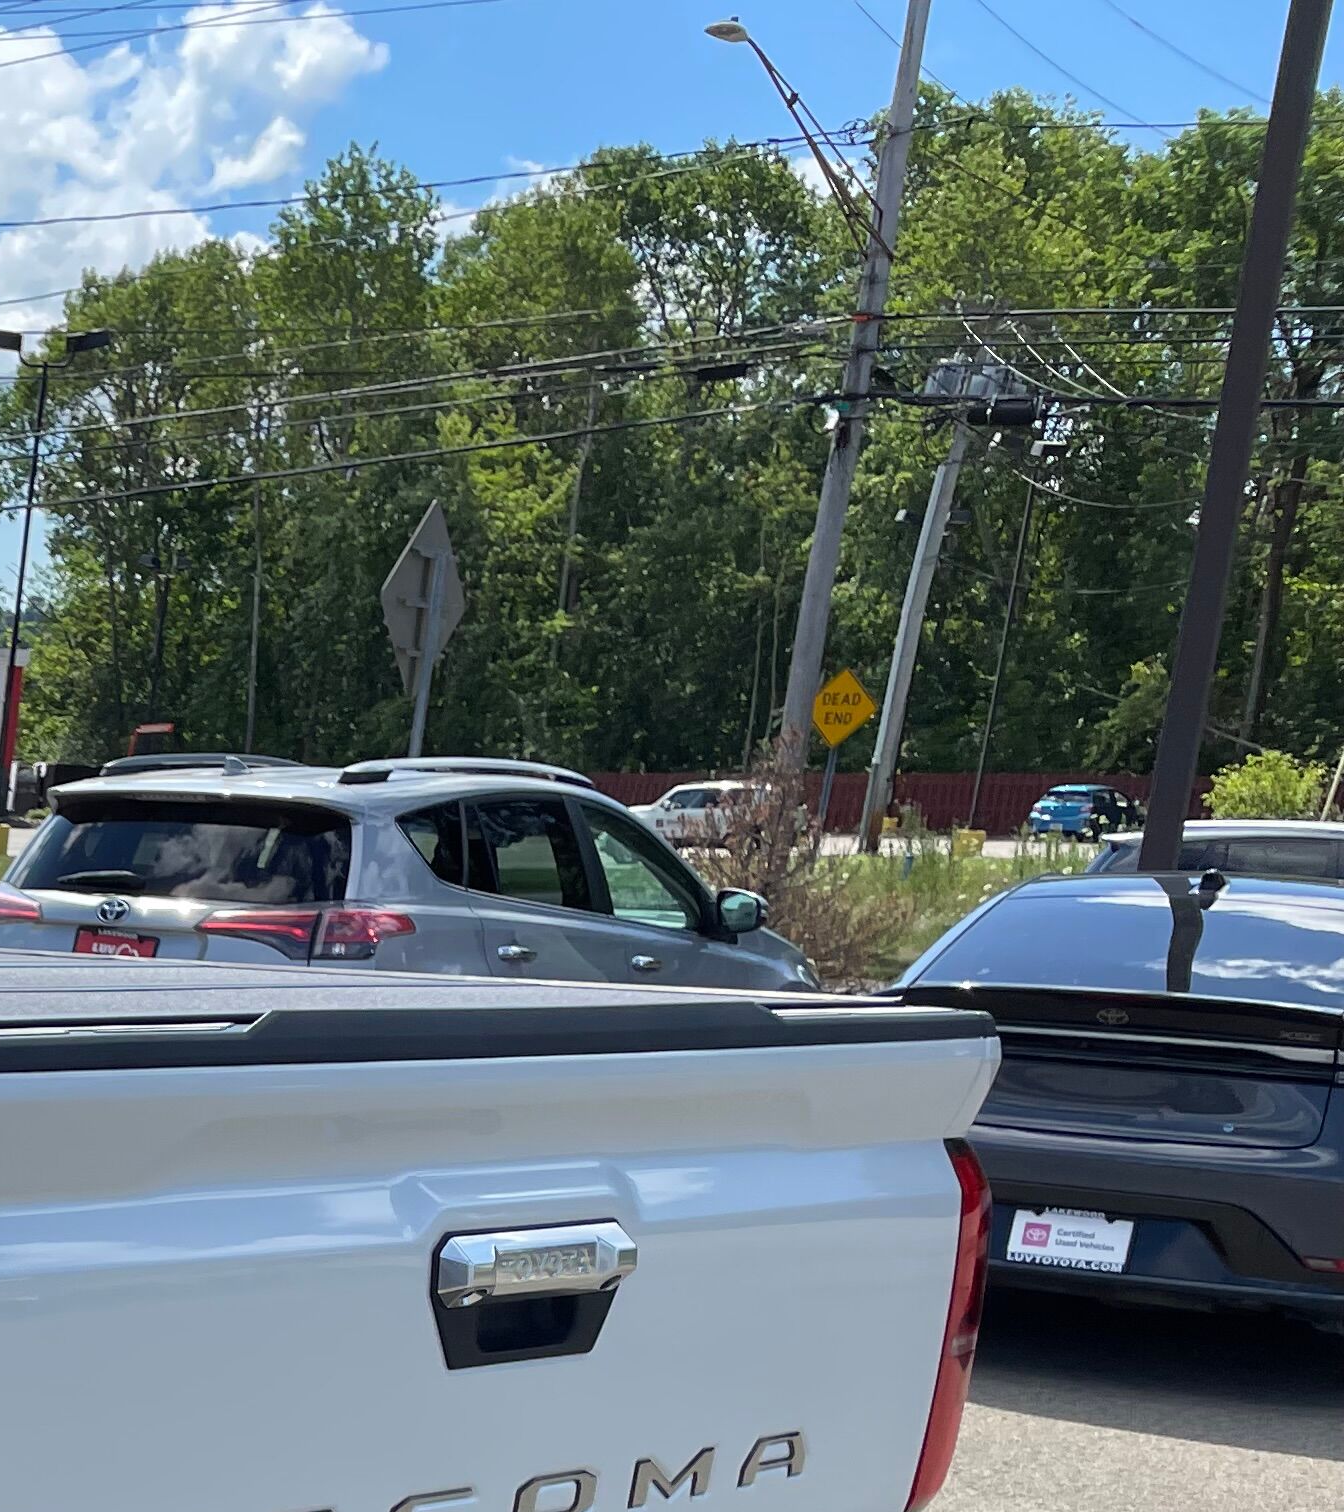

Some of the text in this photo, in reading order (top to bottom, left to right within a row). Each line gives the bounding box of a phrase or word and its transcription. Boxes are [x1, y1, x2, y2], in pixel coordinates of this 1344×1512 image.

[822, 692, 862, 706] DEAD
[823, 712, 853, 725] END
[91, 942, 116, 954] LUV
[1056, 1228, 1096, 1239] Certified
[1055, 1238, 1115, 1252] Used Vehicles
[500, 1248, 592, 1281] TOYOTA
[1007, 1250, 1123, 1274] LUVTOYOTA.COM
